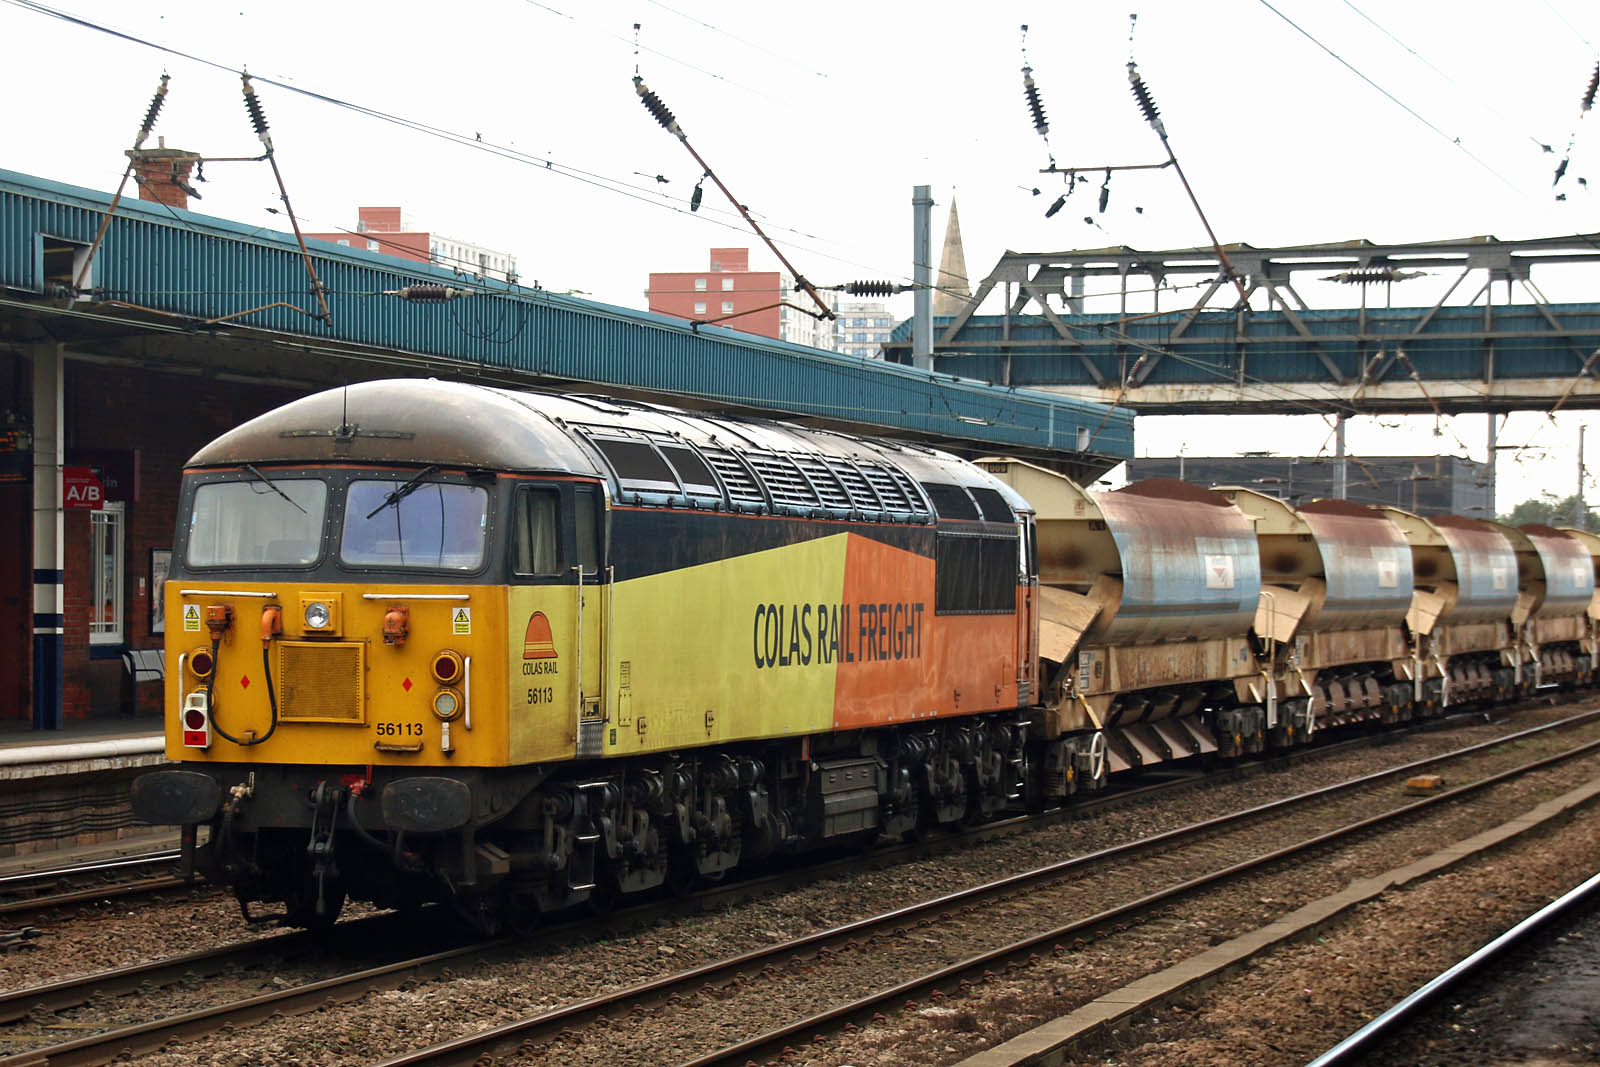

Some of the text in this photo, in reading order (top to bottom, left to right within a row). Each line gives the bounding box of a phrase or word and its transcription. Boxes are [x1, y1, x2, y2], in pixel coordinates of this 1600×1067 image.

[67, 485, 100, 501] A/B
[754, 602, 924, 669] COLAS RAIL FREIGHT
[522, 661, 558, 676] COLAS RAIL
[527, 687, 553, 704] 56113
[376, 722, 423, 736] 56113
